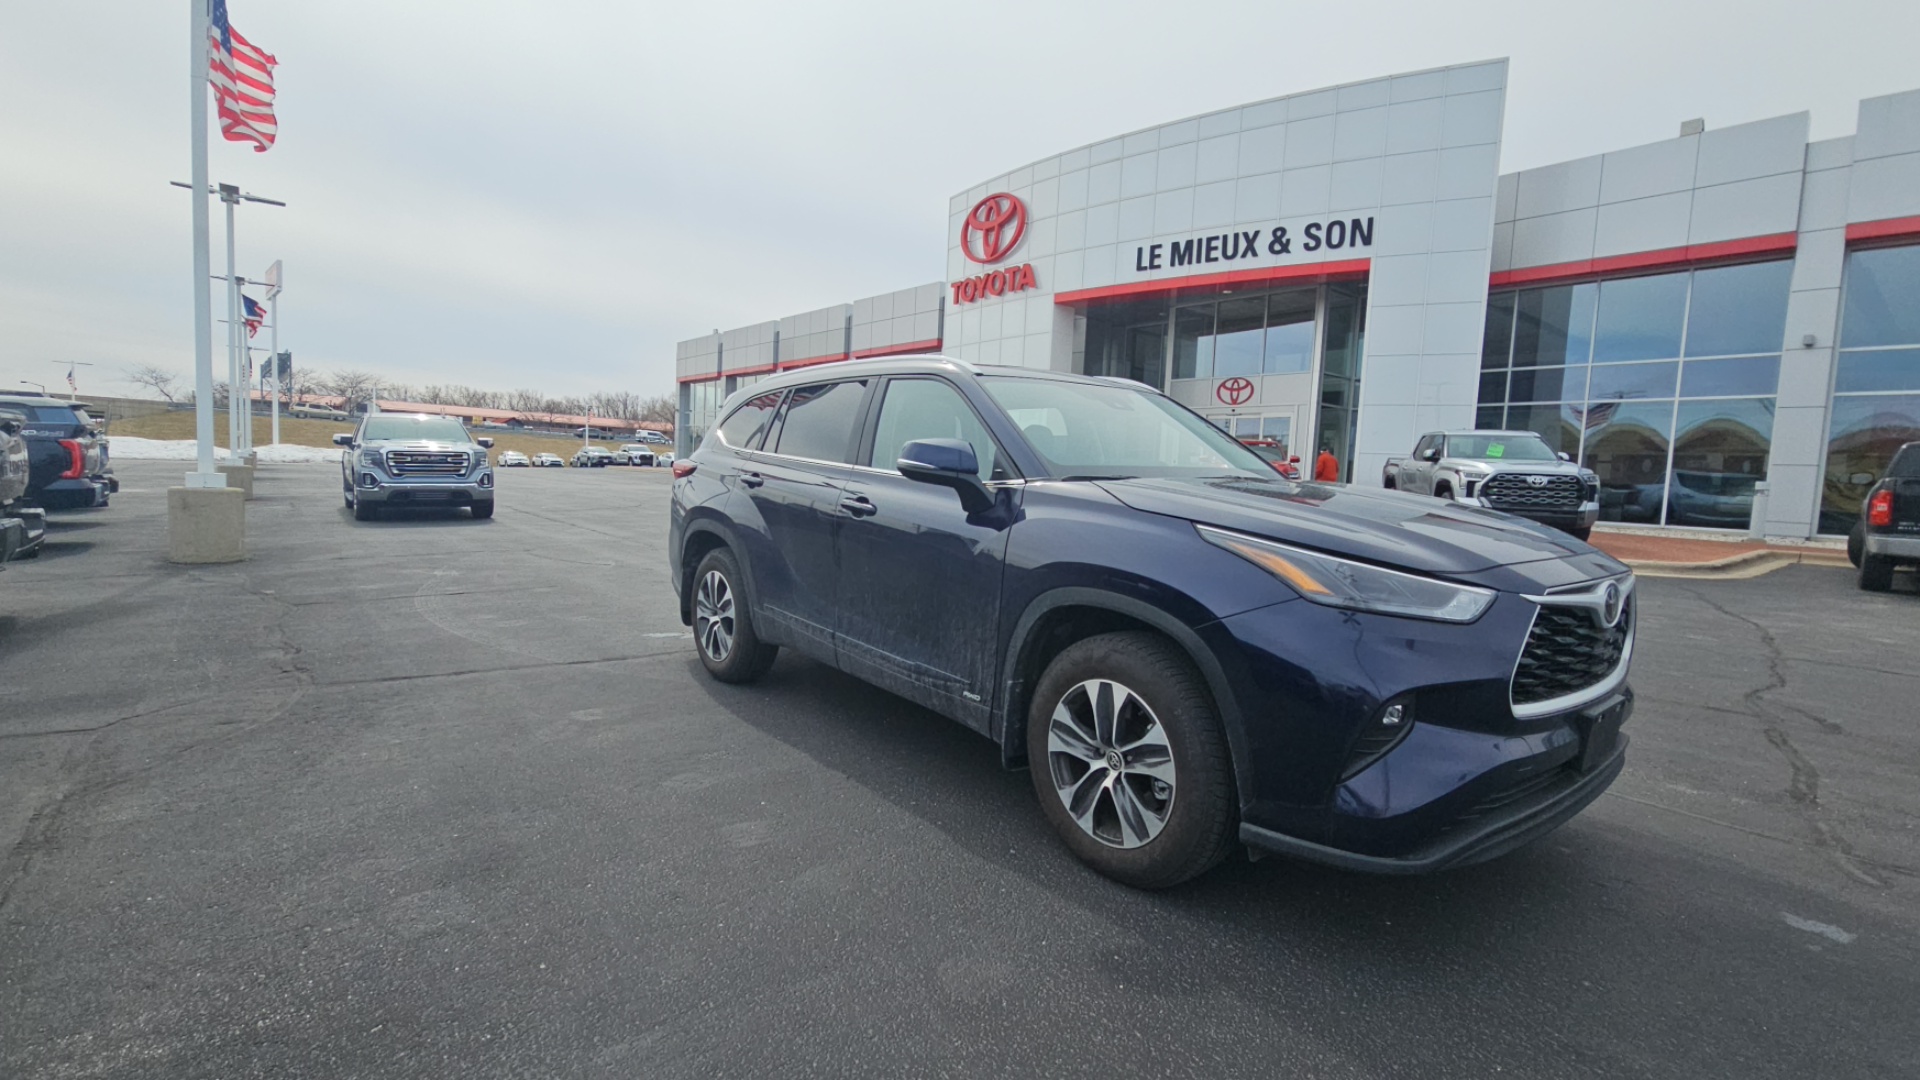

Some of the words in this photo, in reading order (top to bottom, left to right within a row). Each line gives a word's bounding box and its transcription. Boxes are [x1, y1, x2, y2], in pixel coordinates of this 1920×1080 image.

[1136, 244, 1163, 272] LE
[1169, 229, 1261, 267] MIEUX
[1268, 226, 1291, 255] &
[1303, 216, 1374, 252] SON
[951, 263, 1037, 306] TOYOTA
